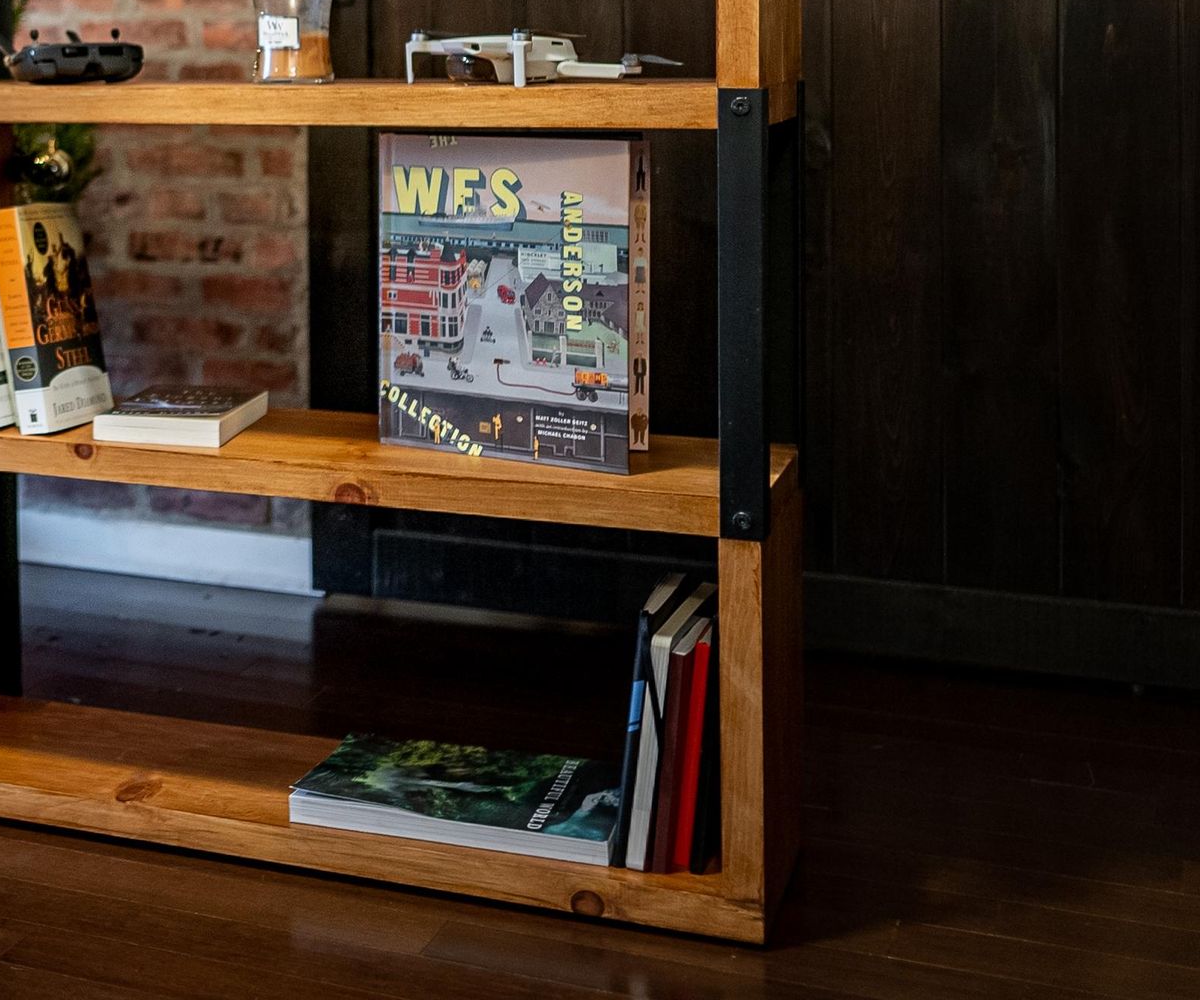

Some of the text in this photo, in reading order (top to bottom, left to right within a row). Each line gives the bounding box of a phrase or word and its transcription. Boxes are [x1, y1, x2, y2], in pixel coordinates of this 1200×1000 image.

[428, 134, 458, 149] THE
[392, 165, 524, 219] WES
[561, 190, 583, 333] ANDERSON
[378, 379, 483, 457] COLLECTION
[526, 802, 555, 830] WORLD
